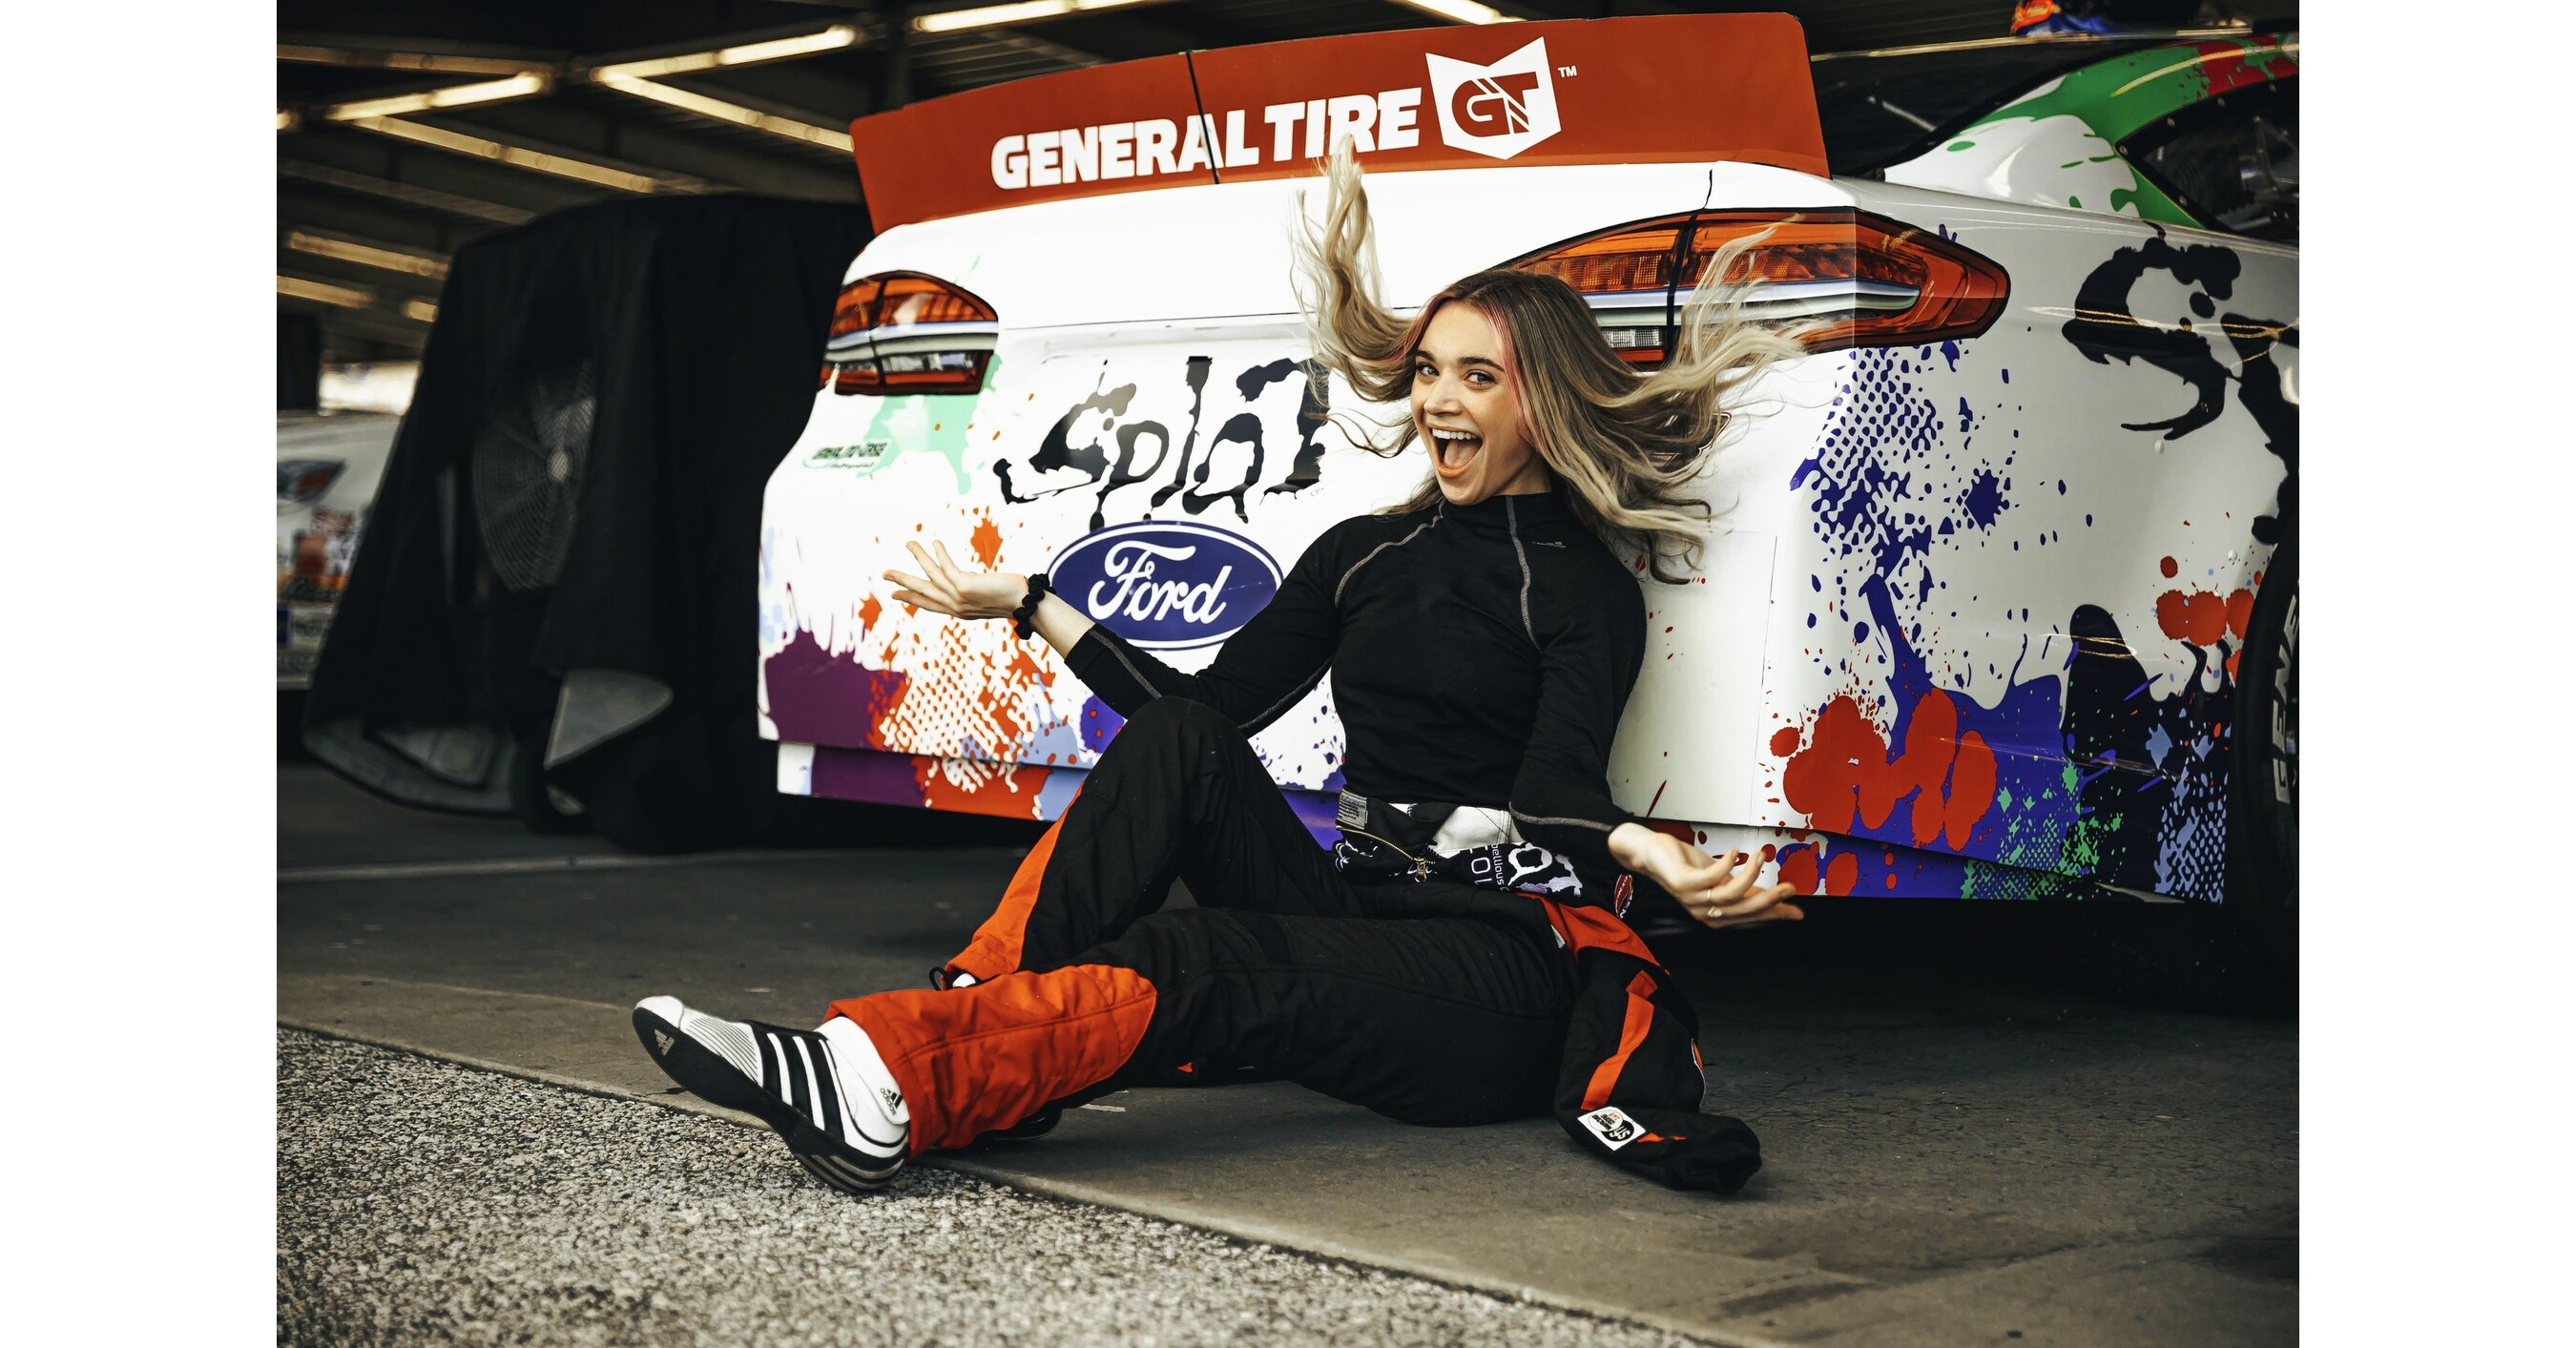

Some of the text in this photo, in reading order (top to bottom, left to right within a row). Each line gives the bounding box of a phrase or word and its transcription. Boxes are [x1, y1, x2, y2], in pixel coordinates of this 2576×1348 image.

[1557, 65, 1578, 78] TM
[990, 87, 1422, 190] GENERAL TIRE
[1088, 540, 1233, 625] Ford
[879, 1087, 898, 1116] adidas
